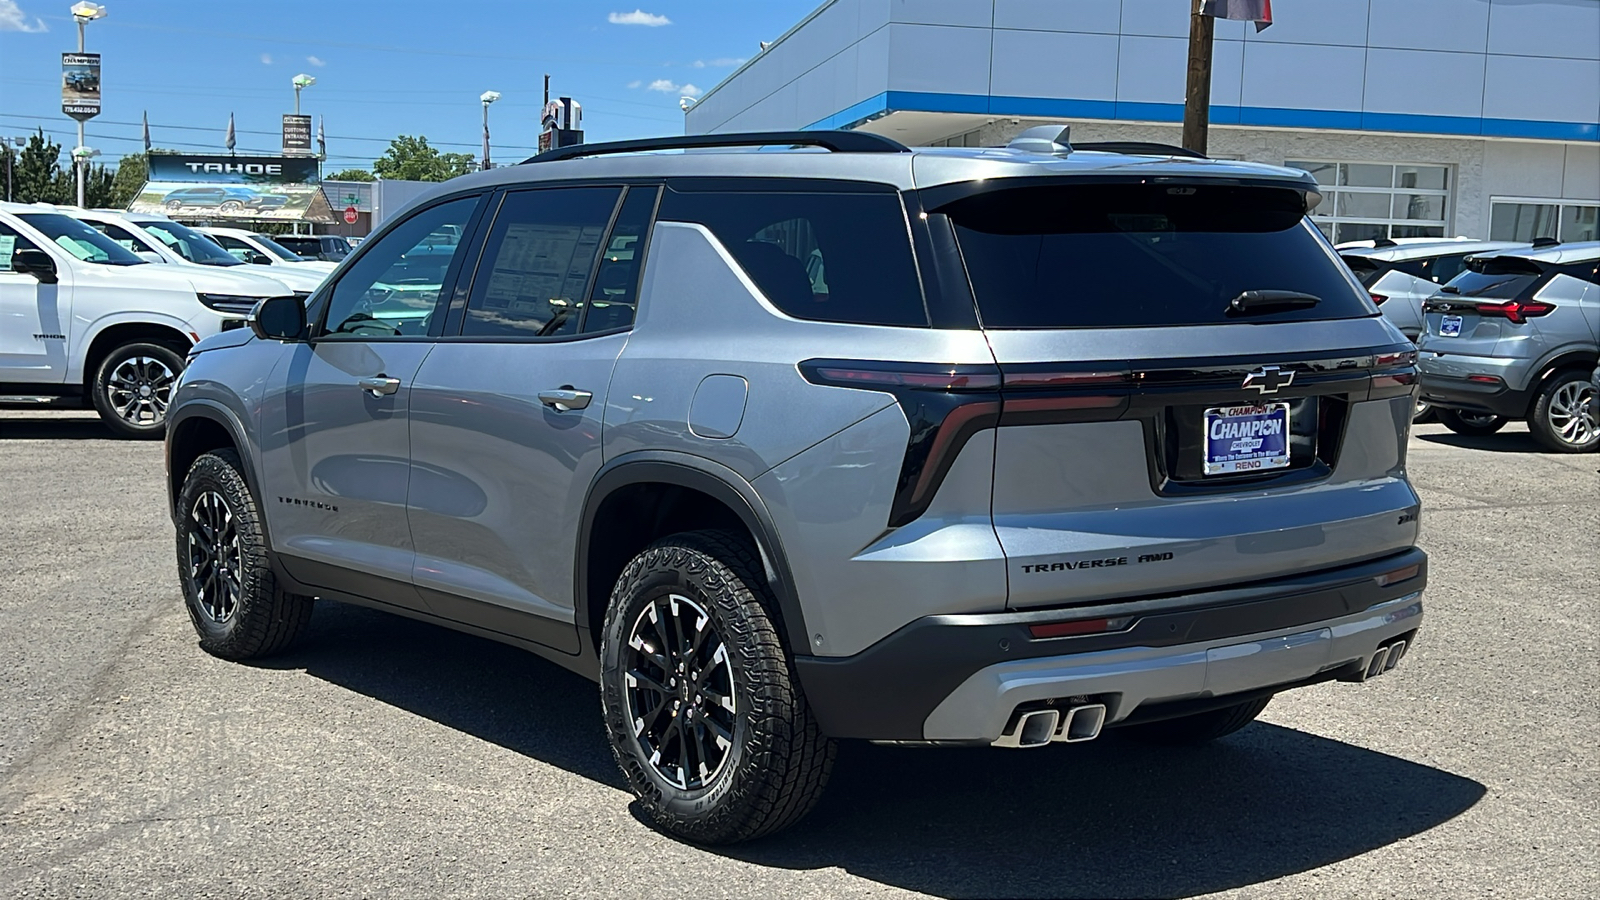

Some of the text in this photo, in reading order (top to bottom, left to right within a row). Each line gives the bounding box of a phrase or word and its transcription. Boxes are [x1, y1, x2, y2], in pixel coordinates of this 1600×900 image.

[185, 162, 282, 175] TAHOE
[1228, 405, 1268, 416] CHAMPION
[1210, 418, 1282, 440] CHAMPION
[1232, 441, 1260, 449] CHEVROLET
[1235, 461, 1261, 470] RENO
[278, 496, 339, 512] TRAVERSE
[1021, 551, 1174, 573] TRAVERSE AWD
